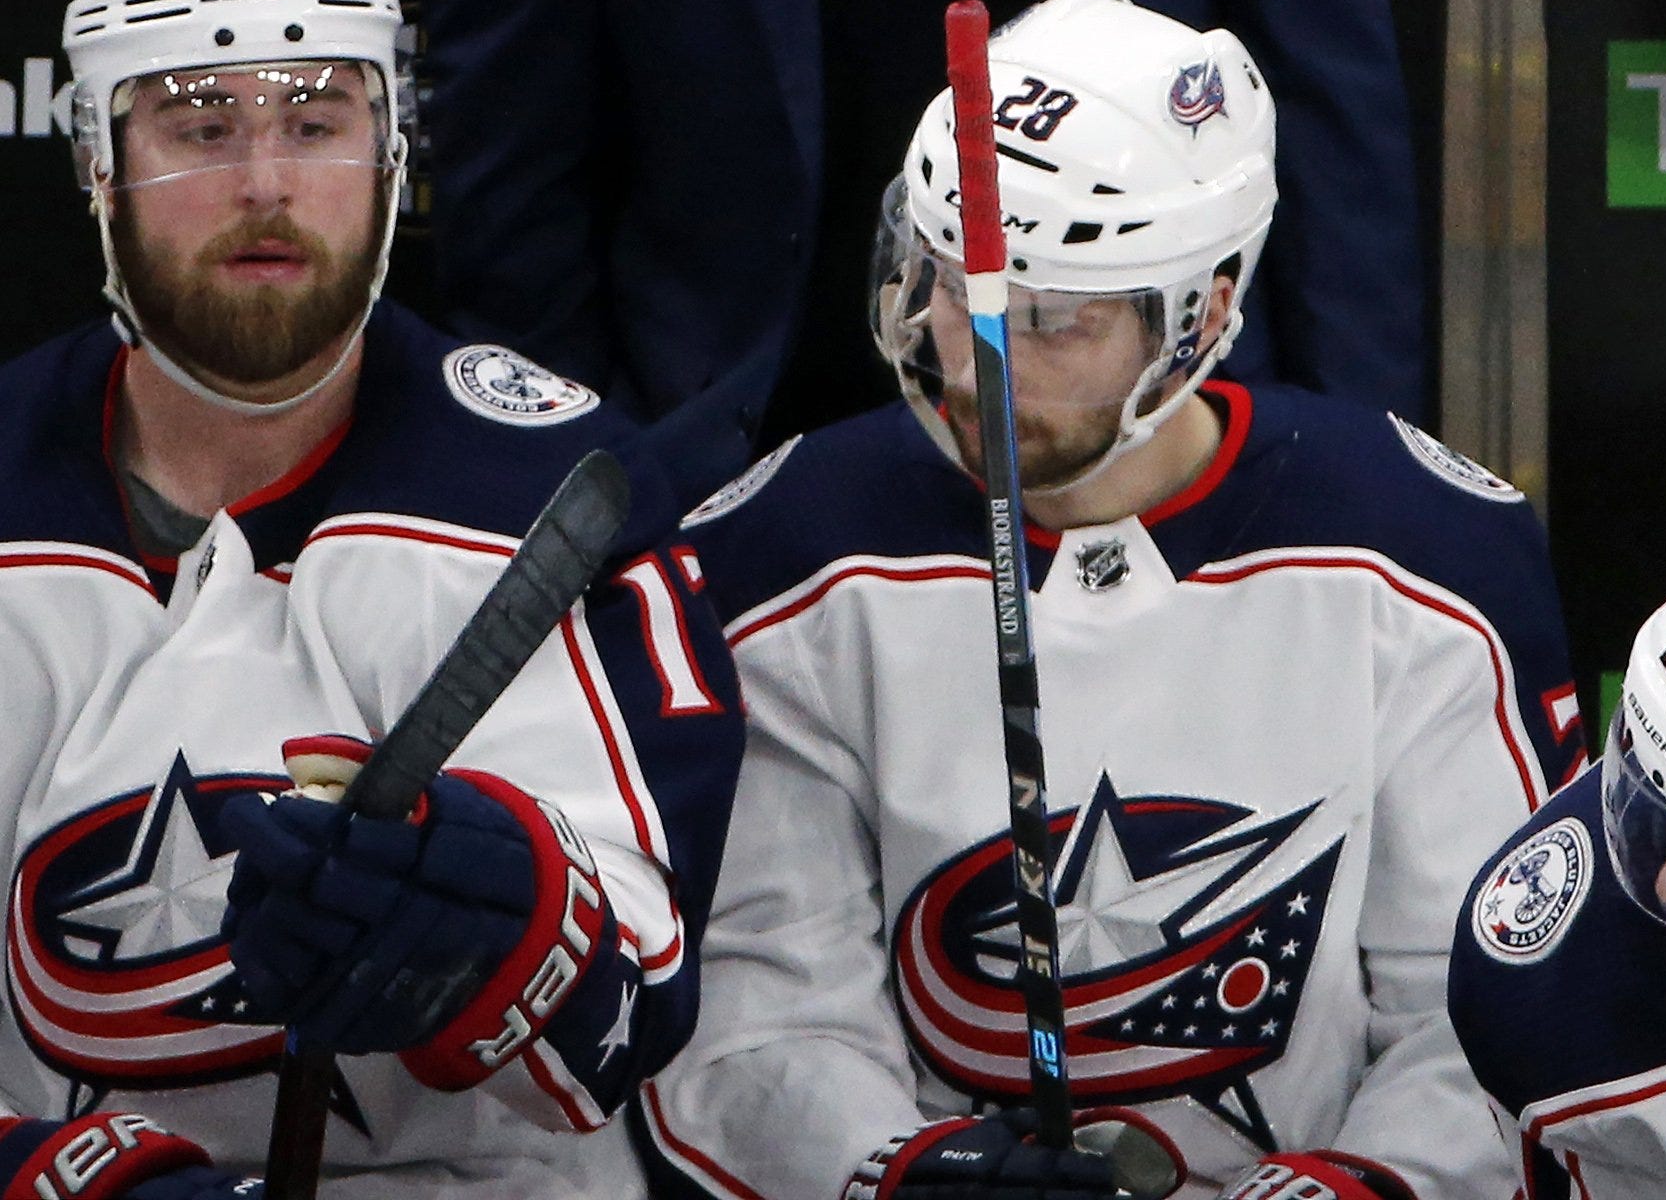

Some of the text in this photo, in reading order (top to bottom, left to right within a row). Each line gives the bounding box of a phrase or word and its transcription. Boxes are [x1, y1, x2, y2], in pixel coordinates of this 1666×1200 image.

[993, 75, 1079, 141] 28
[945, 189, 1041, 234] CM
[470, 800, 601, 1067] AUER
